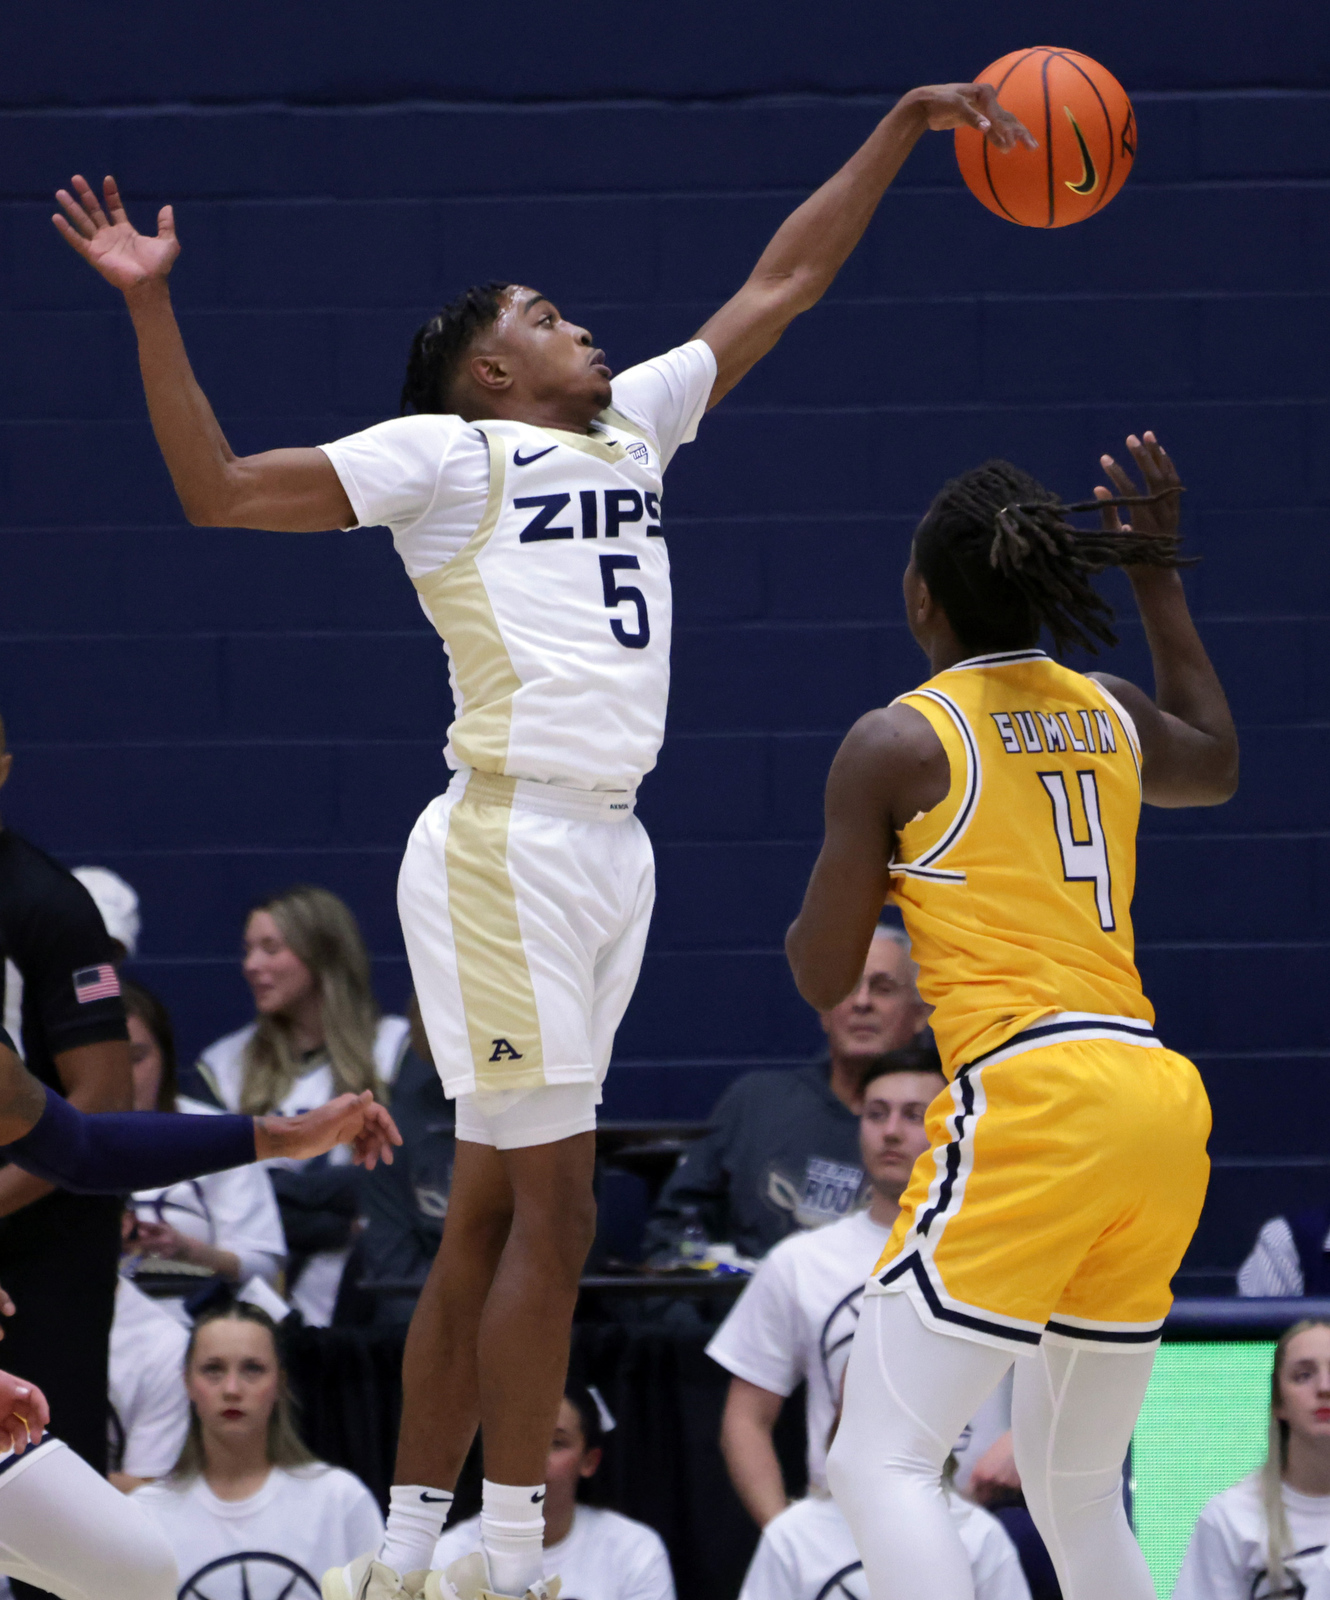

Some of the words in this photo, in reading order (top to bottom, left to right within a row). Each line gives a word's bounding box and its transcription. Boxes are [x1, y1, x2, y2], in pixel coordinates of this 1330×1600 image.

[513, 489, 664, 544] ZIPS
[599, 554, 650, 649] 5
[989, 709, 1117, 753] SUMLIN
[1036, 769, 1116, 932] 4
[488, 1038, 523, 1062] A
